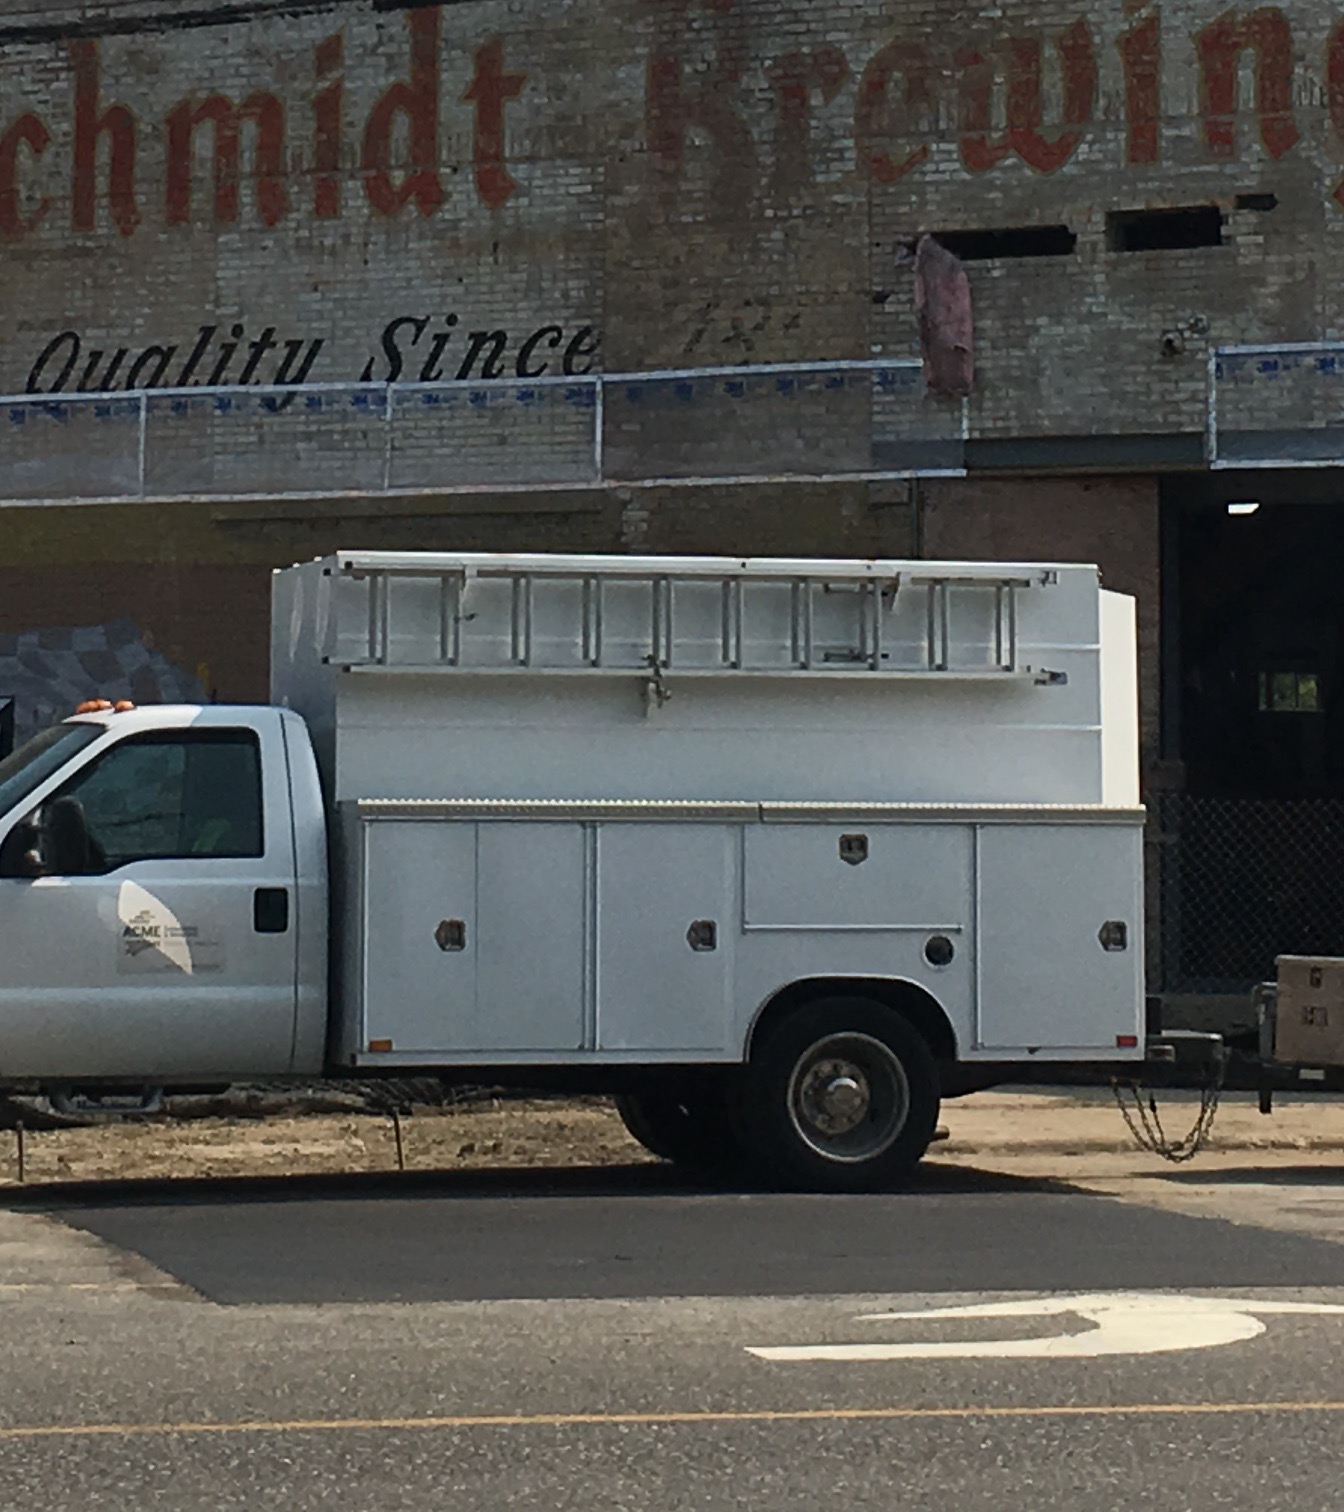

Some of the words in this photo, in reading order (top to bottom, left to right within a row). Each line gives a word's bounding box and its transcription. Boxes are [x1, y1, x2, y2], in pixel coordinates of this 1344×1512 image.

[25, 323, 324, 412] Quality
[359, 314, 602, 386] Since
[123, 925, 161, 938] ACME
